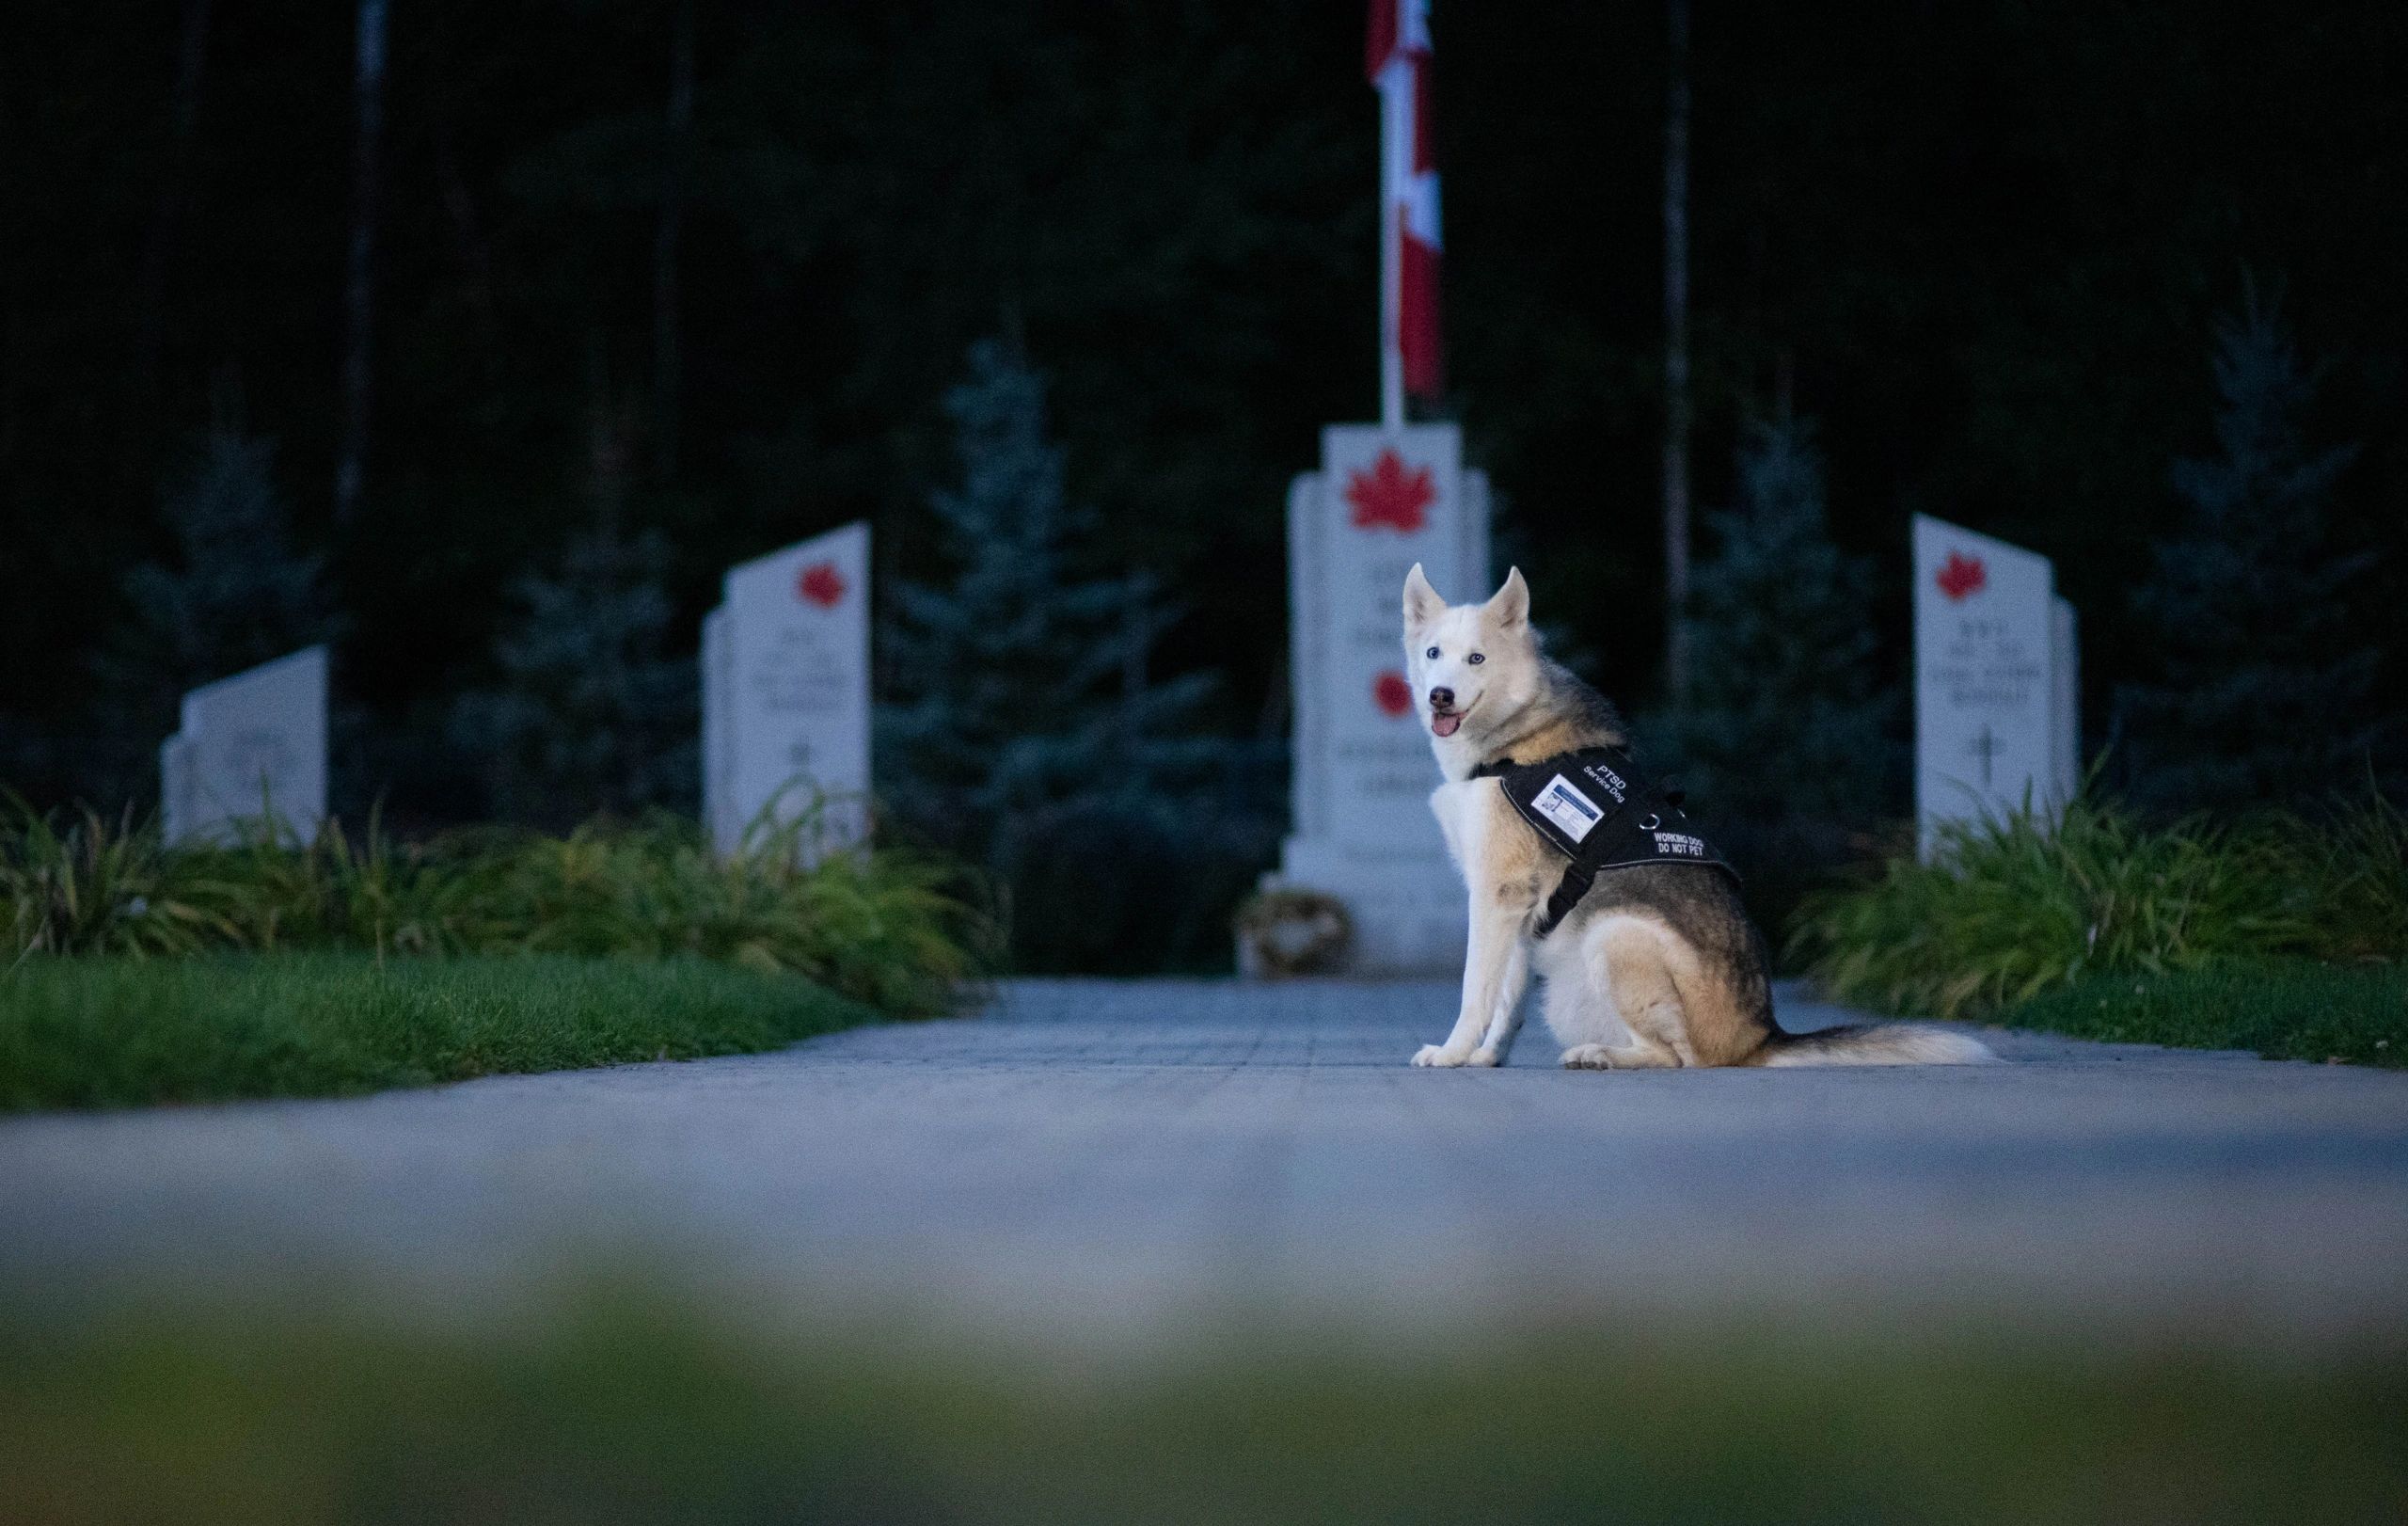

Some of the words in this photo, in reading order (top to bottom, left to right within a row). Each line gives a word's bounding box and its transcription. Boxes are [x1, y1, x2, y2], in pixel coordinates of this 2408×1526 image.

[1584, 766, 1610, 789] Service
[1609, 787, 1625, 803] Dog
[1597, 765, 1626, 789] PTSD
[1654, 832, 1687, 844] WORKING
[1658, 842, 1670, 853] DO
[1671, 843, 1687, 853] NOT
[1688, 845, 1703, 856] PET
